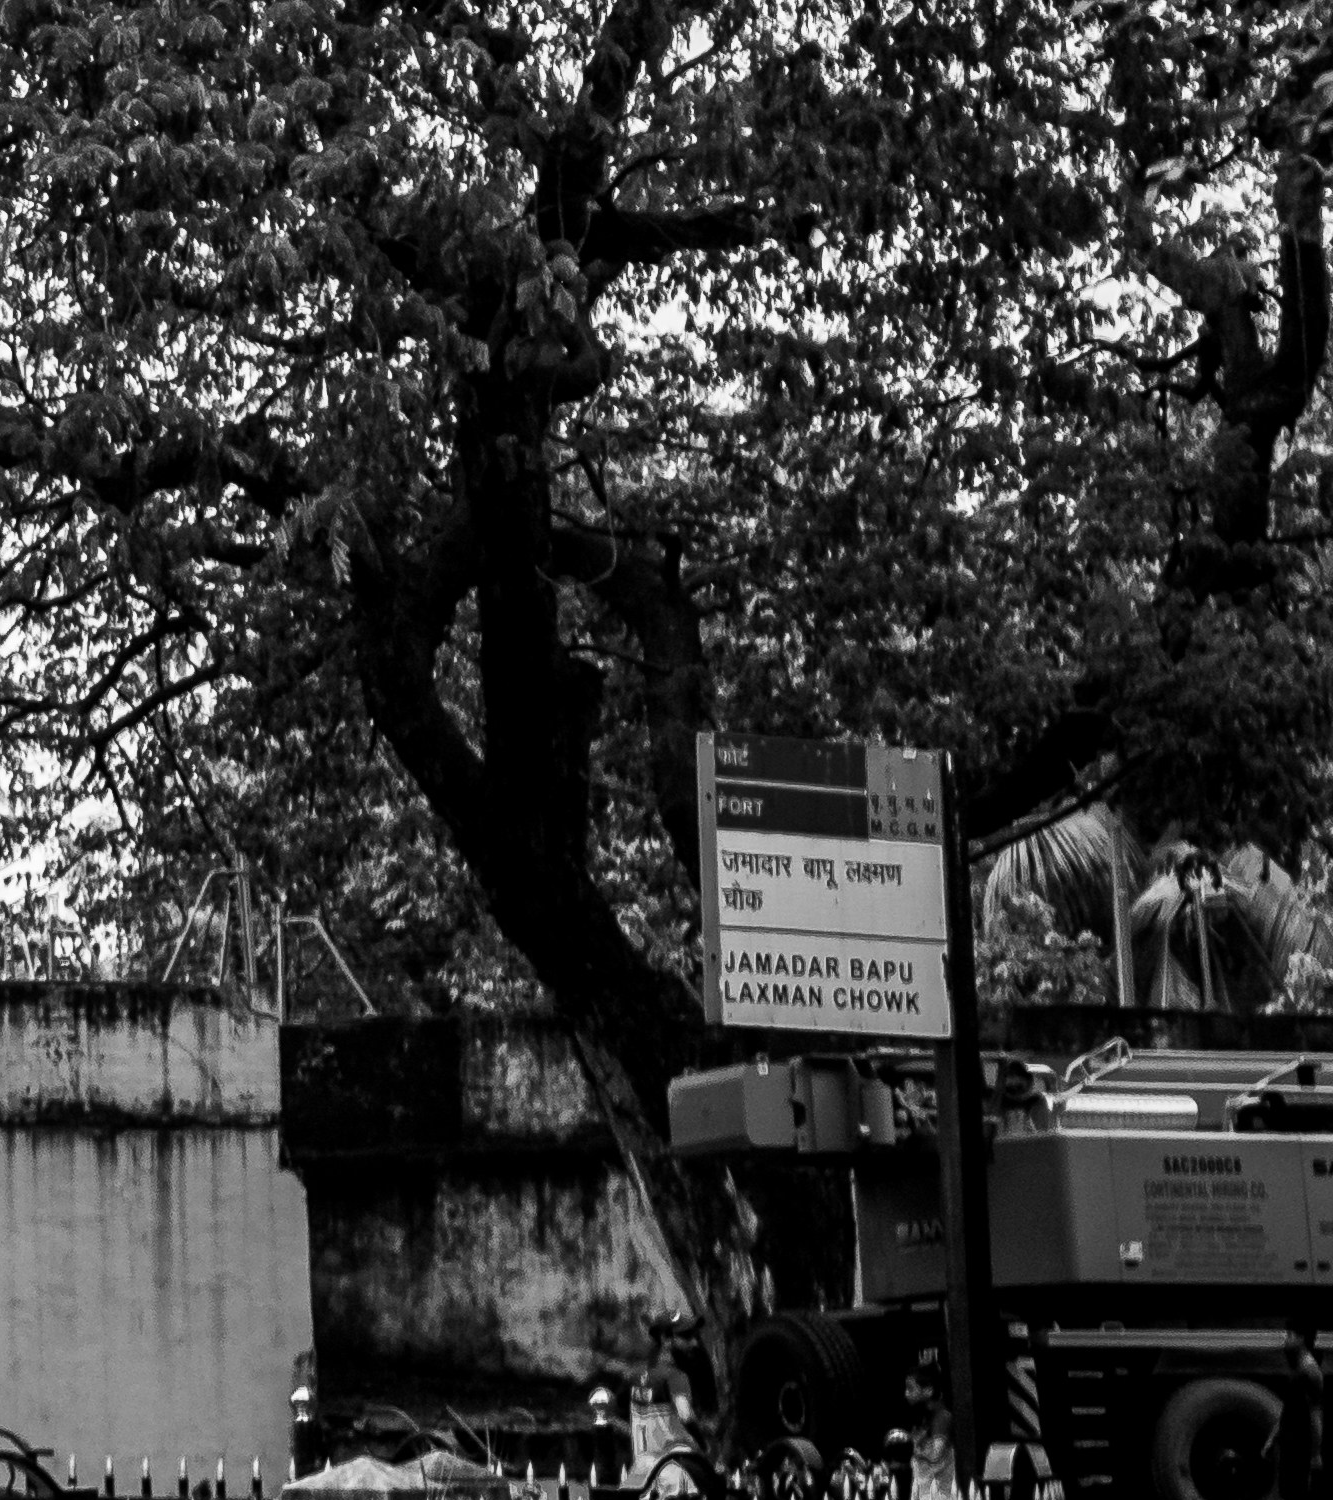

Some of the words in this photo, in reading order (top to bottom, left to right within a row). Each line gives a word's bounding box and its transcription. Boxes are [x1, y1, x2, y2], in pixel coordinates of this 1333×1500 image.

[718, 795, 763, 817] FORT
[721, 849, 793, 878] जमादार
[724, 949, 840, 979] JAMADAR
[849, 957, 914, 985] BAPU
[724, 979, 824, 1009] LAXMAN
[832, 986, 921, 1016] CHOWK
